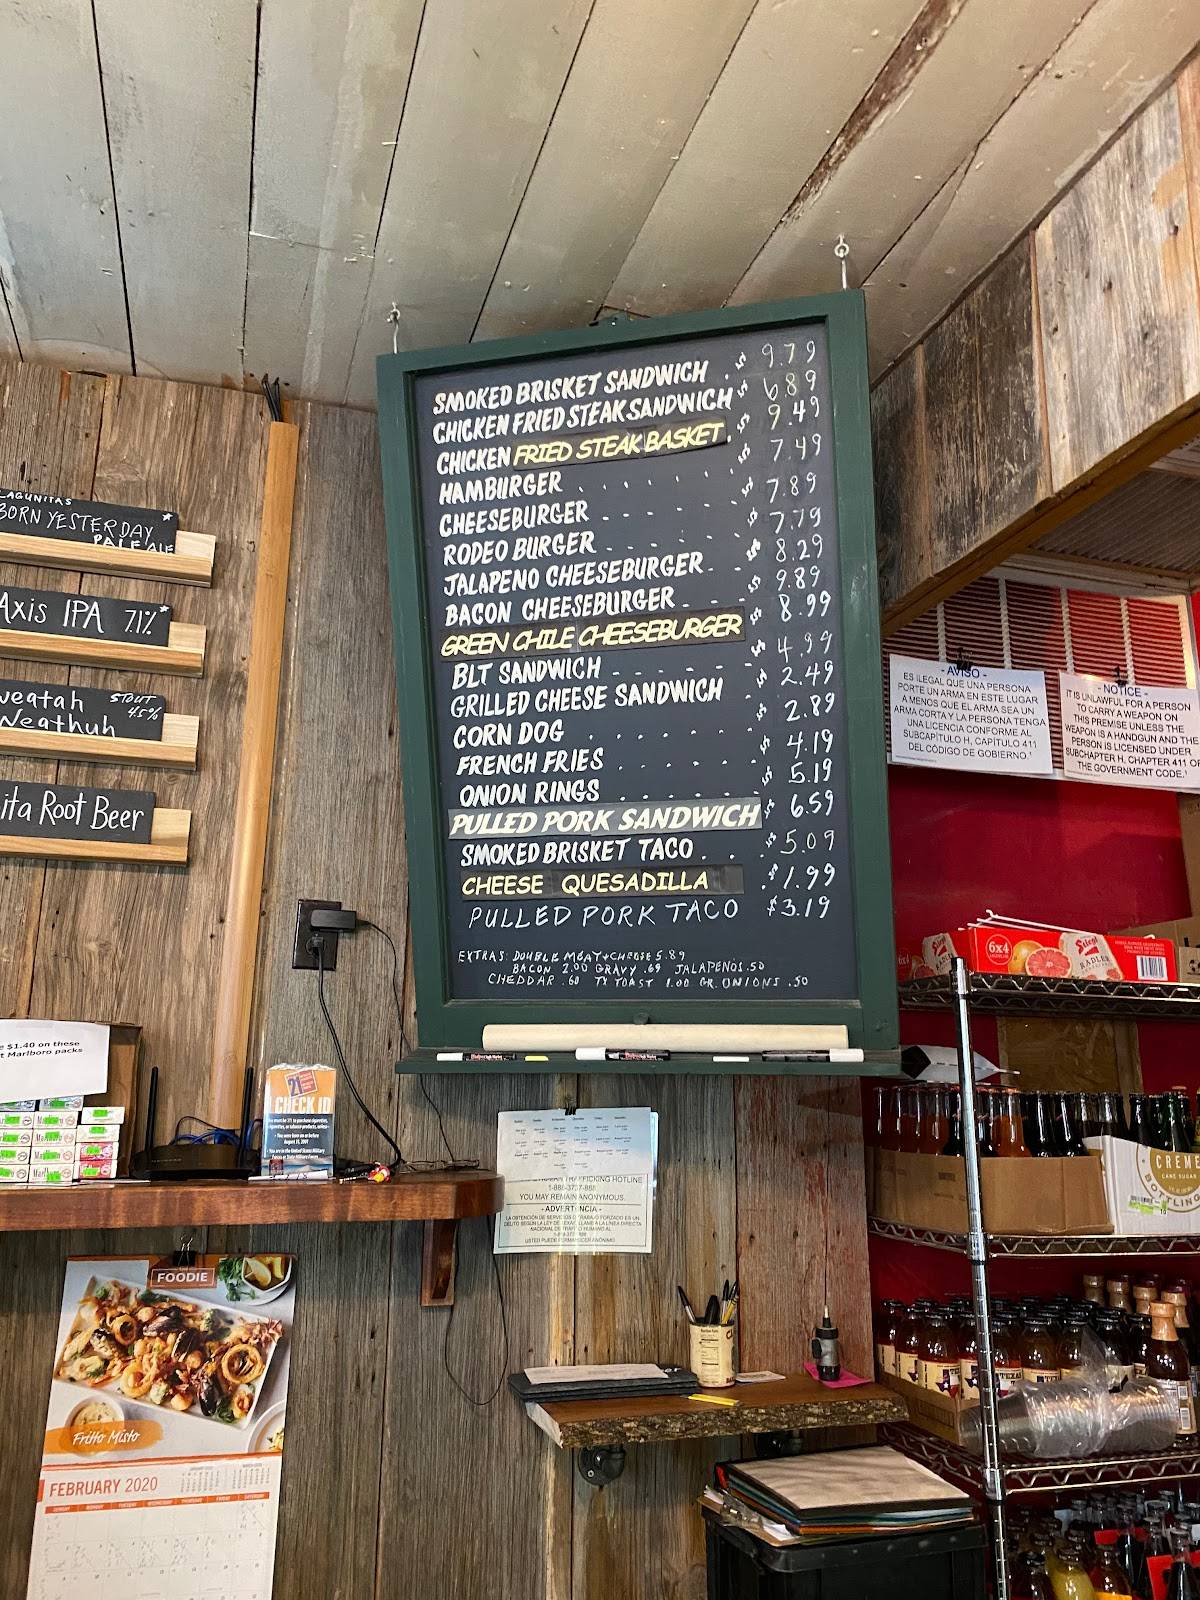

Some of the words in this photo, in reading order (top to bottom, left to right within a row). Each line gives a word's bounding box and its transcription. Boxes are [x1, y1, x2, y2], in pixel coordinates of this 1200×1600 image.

[433, 385, 513, 415] SMOKED
[516, 372, 602, 405] BRISKET
[604, 360, 709, 394] SANDWICH
[433, 413, 510, 444] CHICKEN
[513, 406, 566, 435] FRIED
[567, 399, 627, 429] STEAK
[626, 387, 733, 421] SANDWICH
[437, 447, 511, 475] CHICKEN
[513, 441, 572, 466] FRIED
[576, 433, 644, 459] STEAK
[645, 423, 725, 452] BASKET
[438, 471, 563, 505] HAMBURGER
[46, 510, 153, 545] YESTERDAY
[439, 500, 589, 538] CHEESEBURGER
[444, 540, 508, 566] RODEO
[512, 531, 597, 561] BURGER
[444, 568, 540, 596] JALAPENO
[546, 551, 704, 588] CHEESEBURGER
[62, 599, 105, 634] IPA
[445, 601, 512, 627] BACON
[521, 586, 676, 621] CHEESEBURGER
[441, 631, 510, 657] GREEN
[513, 626, 575, 652] CHILE
[578, 613, 743, 647] CHEESEBURGER
[452, 662, 493, 690] BLT
[499, 656, 602, 685] SANDWICH
[916, 674, 944, 686] ILEGAL
[946, 678, 964, 689] QUE
[966, 680, 986, 690] UNA
[987, 682, 1032, 694] PERSONA
[109, 693, 157, 705] STOUT
[451, 690, 531, 718] GRILLED
[535, 685, 608, 713] CHEESE
[614, 677, 724, 707] SANDWICH
[898, 682, 925, 695] PORTE
[927, 687, 939, 697] UN
[940, 688, 965, 700] ARMA
[967, 691, 979, 701] EN
[981, 693, 1005, 703] ESTE
[1006, 695, 1039, 705] LUGAR
[1103, 684, 1141, 697] NOTICE
[1074, 714, 1089, 724] THIS
[1091, 716, 1127, 730] PREMISE
[1129, 721, 1164, 732] UNLESS
[1165, 725, 1184, 733] THE
[1077, 703, 1087, 712] TO
[1088, 705, 1115, 717] CARRY
[1123, 709, 1163, 721] WEAPON
[1164, 713, 1178, 722] ON
[453, 723, 512, 750] CORN
[518, 719, 564, 745] DOG
[907, 718, 924, 729] UNA
[925, 721, 965, 734] LICENCIA
[966, 724, 1019, 737] CONFORME
[1020, 728, 1032, 737] AL
[1065, 723, 1096, 737] WEAPON
[1114, 732, 1157, 743] HANDGUN
[1159, 735, 1178, 744] AND
[1180, 737, 1199, 745] THE
[456, 752, 538, 776] FRENCH
[541, 747, 604, 774] FRIES
[460, 783, 527, 808] ONION
[534, 779, 600, 804] RINGS
[39, 789, 87, 826] Root
[90, 795, 145, 831] Beer
[449, 811, 538, 836] PULLED
[541, 809, 615, 833] PORK
[617, 803, 762, 831] SANDWICH
[460, 841, 541, 868] SMOKED
[542, 837, 632, 865] BRISKET
[638, 837, 694, 861] TACO
[462, 874, 544, 896] CHEESE
[561, 871, 709, 896] QUESADILLA
[468, 905, 572, 929] PULLED
[582, 905, 656, 928] PORK
[665, 899, 739, 923] TACO
[512, 963, 551, 974] BACON
[595, 964, 637, 976] GRAVY
[513, 950, 559, 963] DOUBLE
[488, 973, 555, 985] CHEDDAR
[7, 1042, 35, 1050] $1.40
[8, 1049, 51, 1058] Marlboro
[275, 1096, 315, 1114] CHECK
[318, 1097, 331, 1114] ID
[157, 1272, 208, 1283] FOODIE
[107, 1429, 140, 1445] Misto
[49, 1478, 121, 1497] FEBRUARY
[125, 1477, 158, 1494] 2020
